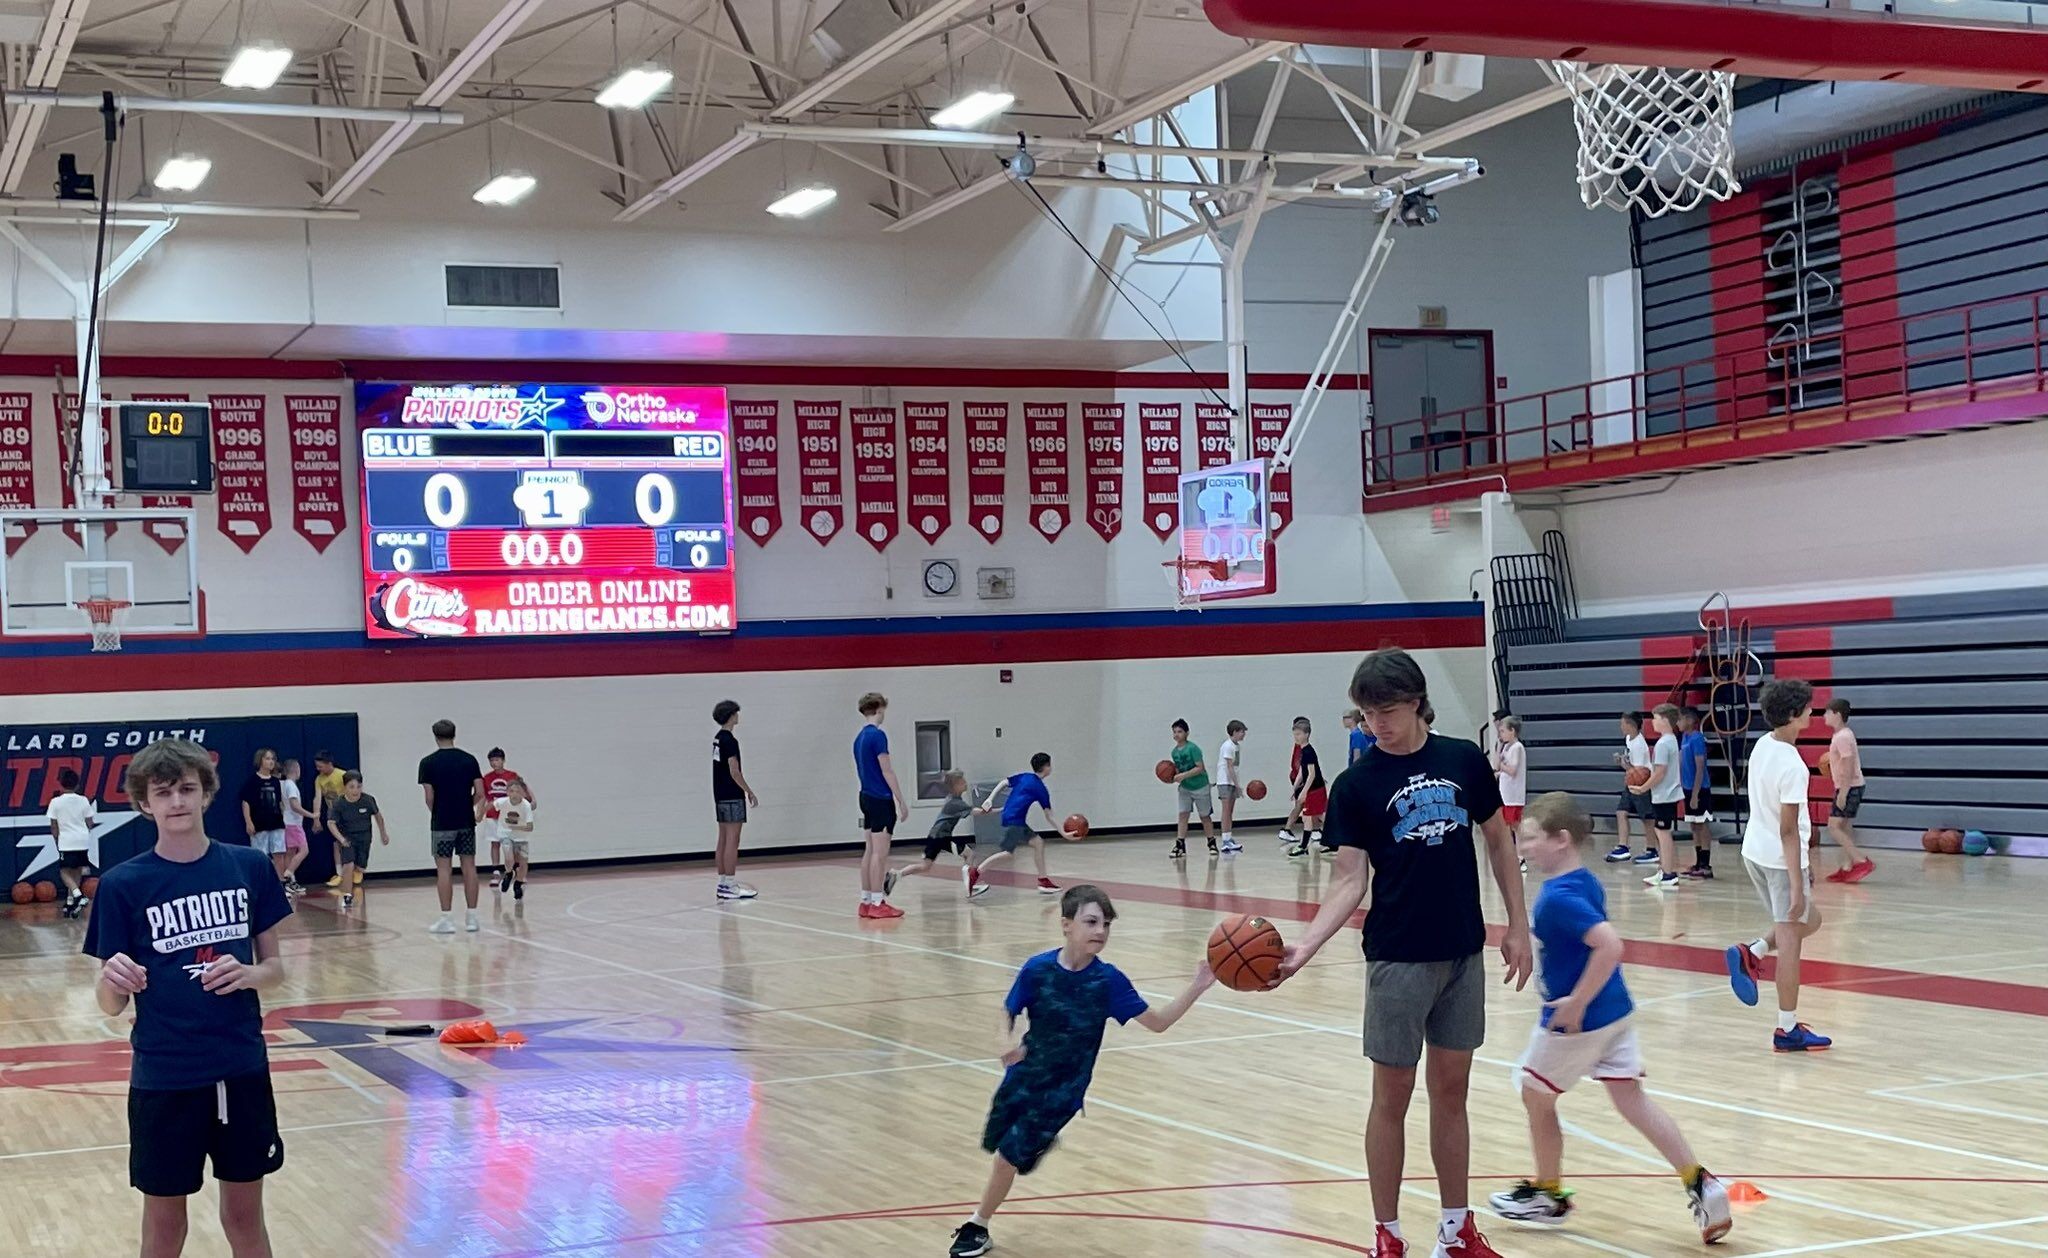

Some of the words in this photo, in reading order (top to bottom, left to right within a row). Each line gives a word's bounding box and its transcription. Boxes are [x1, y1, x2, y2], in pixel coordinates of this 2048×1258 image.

[213, 399, 262, 410] MILLARD
[290, 399, 337, 410] MILLARD
[616, 392, 666, 410] Ortho
[220, 411, 256, 422] SOUTH
[296, 412, 331, 423] SOUTH
[402, 397, 522, 422] PATRIOTS
[616, 406, 697, 424] Nebraska
[734, 406, 775, 416] MILLARD
[798, 406, 838, 416] MILLARD
[907, 407, 946, 417] MILLARD
[966, 407, 1006, 417] MILLARD
[1027, 408, 1065, 417] MILLARD
[1085, 407, 1122, 418] MILLARD
[1142, 407, 1179, 418] MILLARD
[148, 412, 184, 436] 0.0
[853, 414, 893, 423] MILLARD
[0, 427, 29, 445] 89
[217, 428, 262, 446] 1996
[293, 428, 337, 446] 1996
[737, 436, 776, 452] 1940
[801, 436, 837, 452] 1951
[909, 436, 946, 452] 1954
[969, 436, 1006, 452] 1958
[1145, 436, 1179, 452] 1976
[368, 435, 432, 456] BLUE
[674, 435, 720, 456] RED
[855, 442, 894, 458] 1953
[1029, 437, 1066, 452] 1966
[1088, 437, 1122, 452] 1975
[225, 451, 257, 460] GRAND
[219, 461, 265, 471] CHAMPION
[294, 461, 339, 471] CHAMPION
[223, 477, 247, 487] CLASS
[298, 477, 322, 487] CLASS
[233, 492, 254, 502] ALL
[308, 492, 329, 502] ALL
[424, 472, 467, 528] 0
[541, 489, 564, 518] 1
[635, 472, 675, 526] 0
[223, 502, 265, 512] SPORTS
[298, 502, 339, 512] SPORTS
[501, 534, 584, 566] 00.0
[690, 544, 709, 569] 0
[392, 548, 413, 573] 0
[508, 581, 593, 605] ORDER
[600, 579, 692, 603] ONLINE
[475, 605, 730, 634] RAISINGCANES.COM
[0, 733, 88, 750] LARD
[104, 729, 206, 747] SOUTH
[146, 888, 249, 940] PATRIOTS
[165, 928, 241, 951] BASKETBALL
